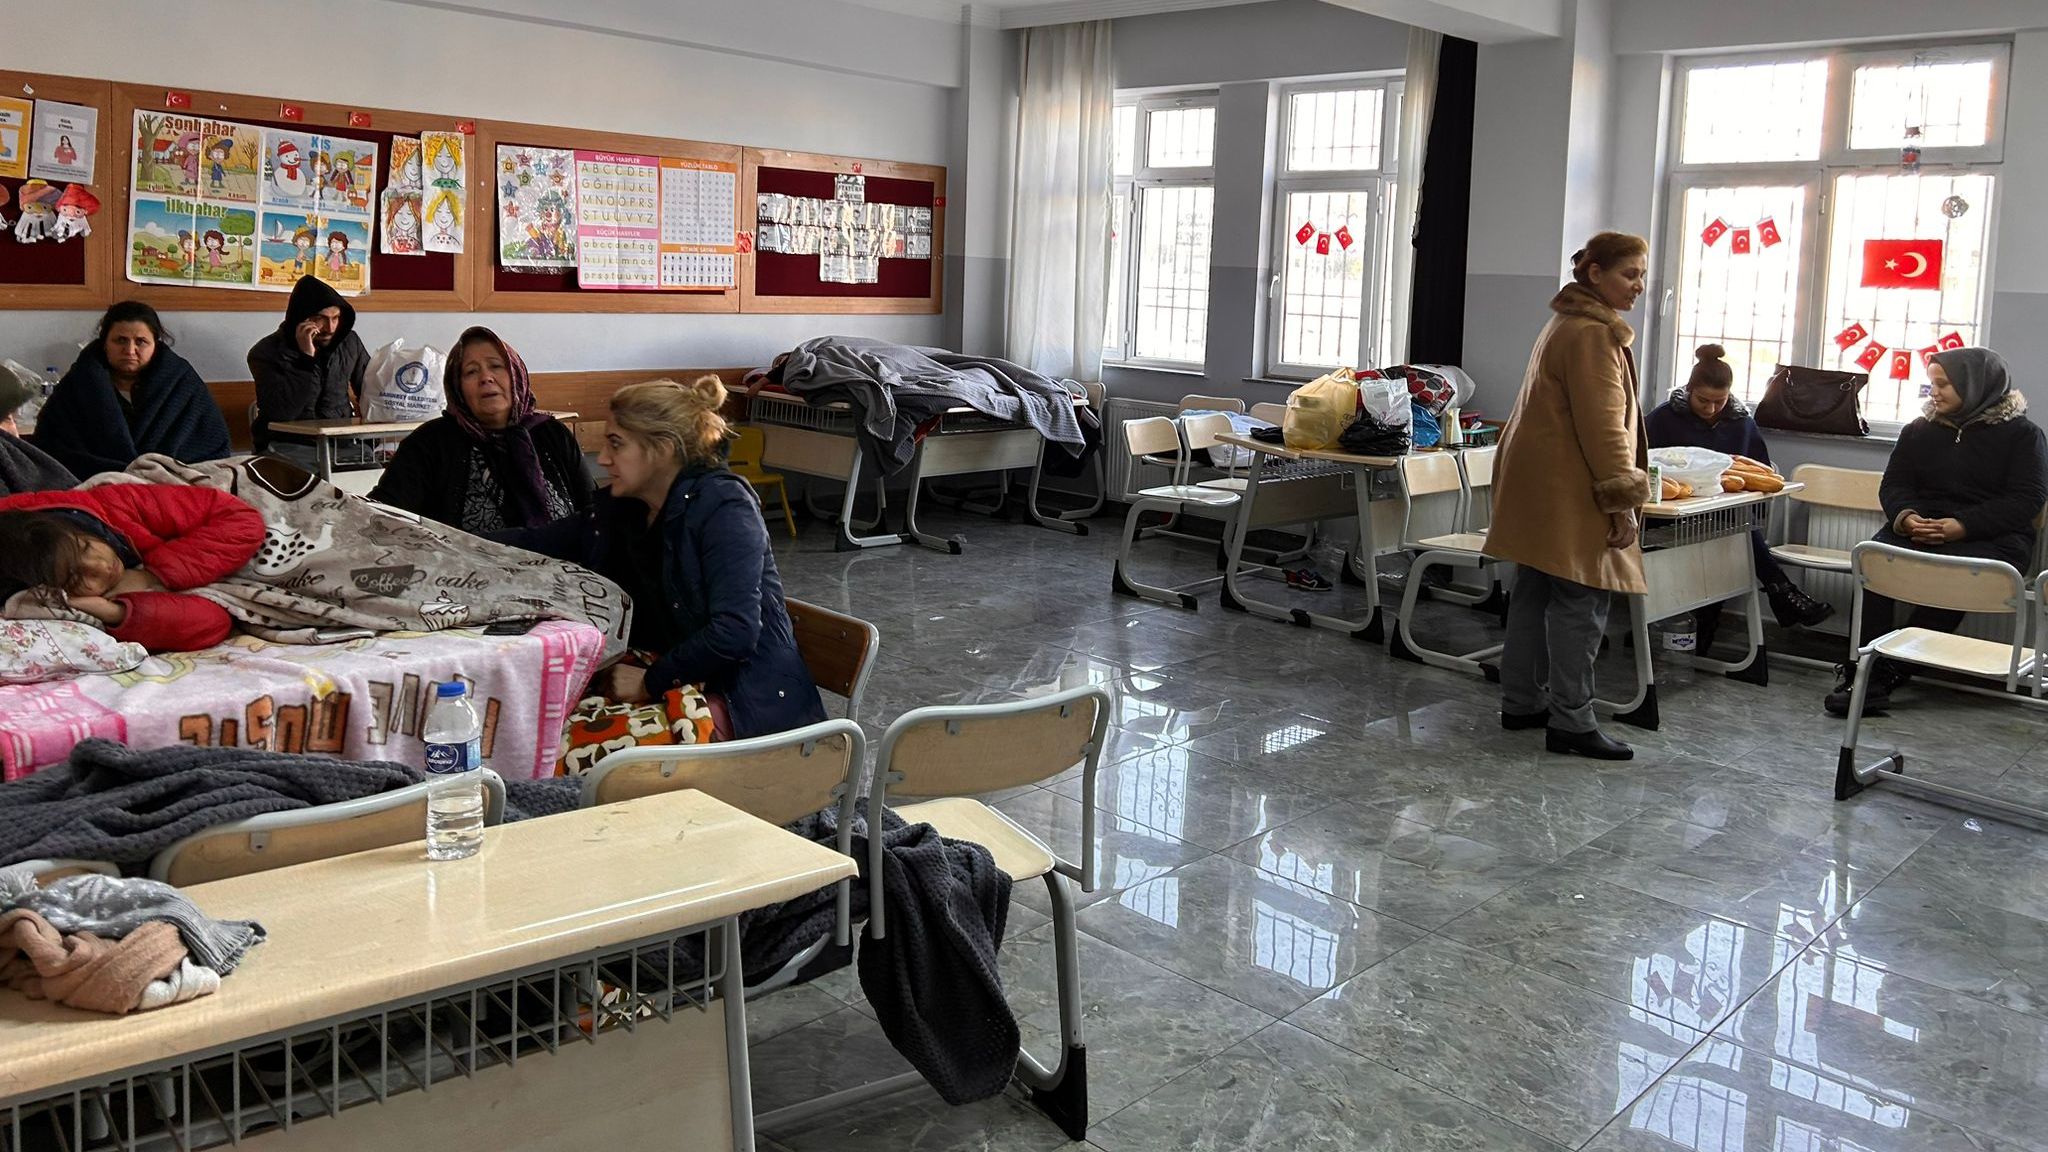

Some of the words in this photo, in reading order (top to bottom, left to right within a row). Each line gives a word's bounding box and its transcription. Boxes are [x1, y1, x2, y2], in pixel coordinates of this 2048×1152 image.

[165, 116, 236, 136] Sonbahar
[385, 400, 406, 408] SOSYAL
[354, 572, 410, 593] Coffee
[435, 572, 490, 590] cake
